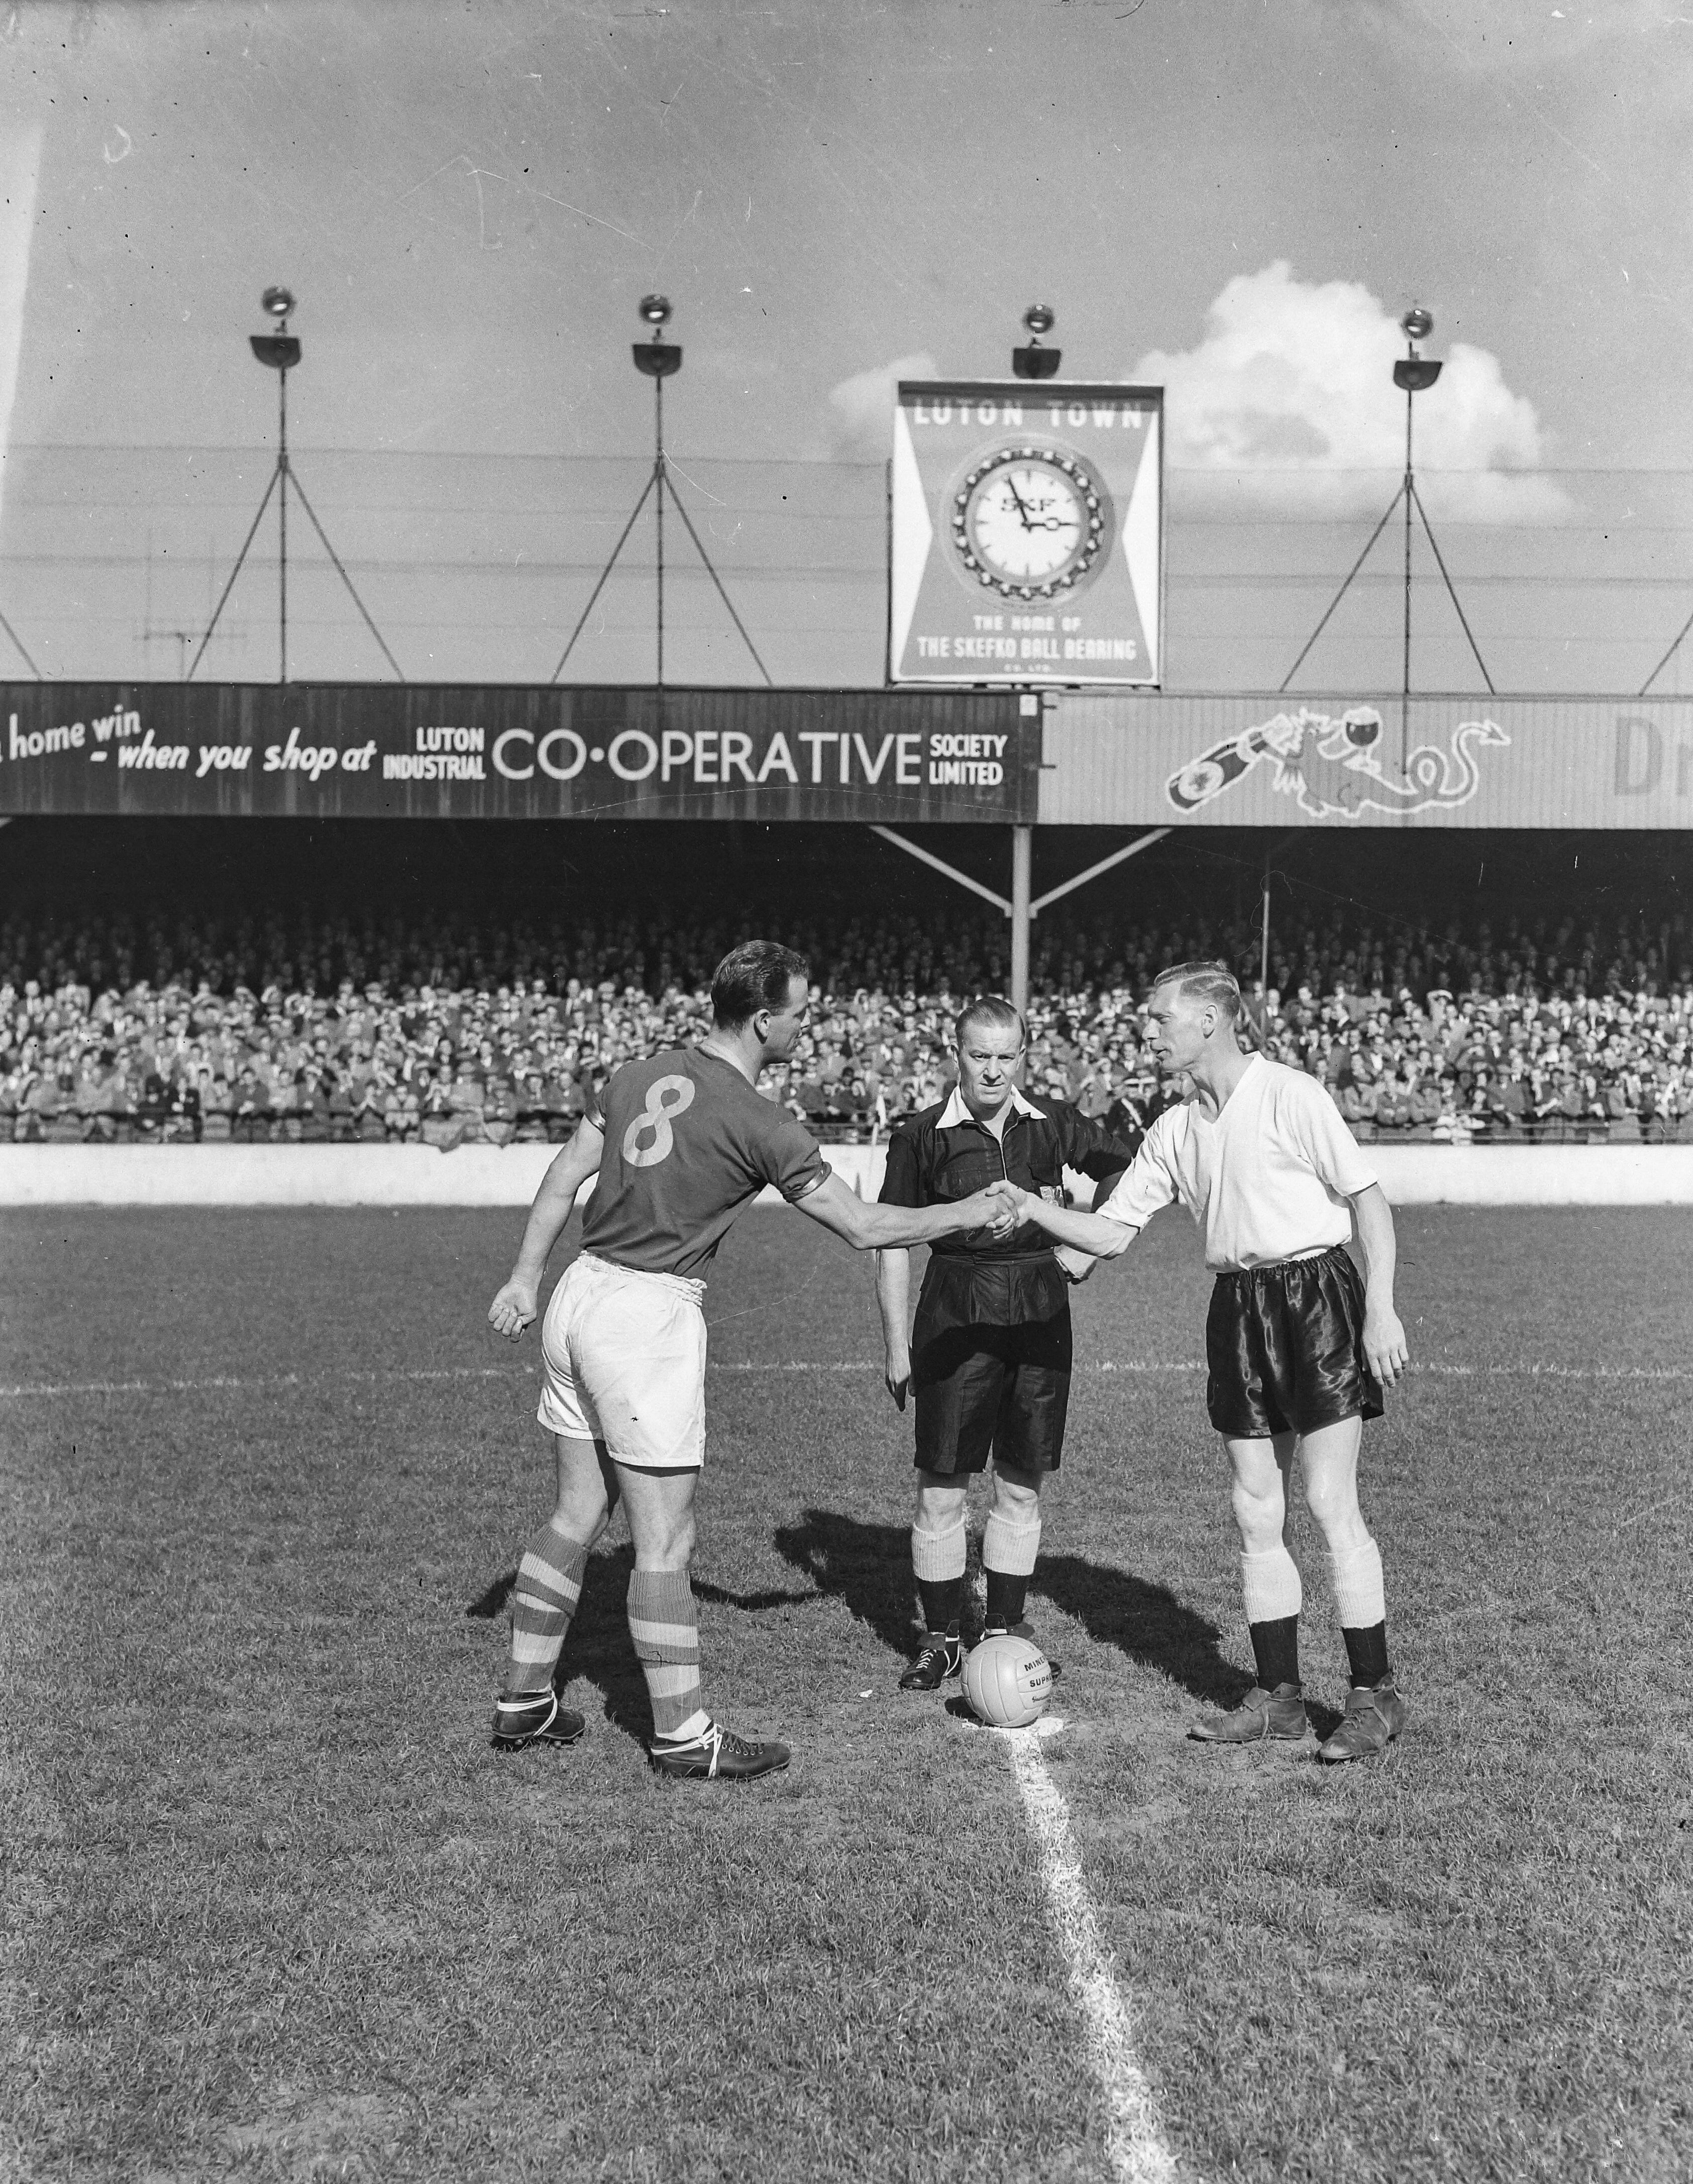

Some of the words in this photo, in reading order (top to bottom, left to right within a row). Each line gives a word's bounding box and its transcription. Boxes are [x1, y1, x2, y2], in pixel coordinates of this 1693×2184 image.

[913, 397, 1023, 426] LUTON
[1047, 400, 1142, 428] TOWN
[973, 615, 1004, 631] THE
[1011, 615, 1055, 632] HOME
[1062, 616, 1081, 631] OF
[917, 635, 950, 658] THE
[954, 636, 1017, 659] SKEFKO
[1020, 637, 1061, 660] BALL
[1064, 638, 1137, 661] BEARING
[9, 713, 85, 760] home
[91, 704, 141, 742] win
[416, 727, 485, 752] LUTON
[118, 728, 190, 770] when
[195, 745, 253, 778] you
[263, 727, 338, 782] shop
[341, 740, 377, 772] at
[930, 733, 1008, 758] SOCIETY
[383, 754, 487, 780] INDUSTRIAL
[929, 760, 1003, 786] LIMITED
[623, 1074, 695, 1167] 8
